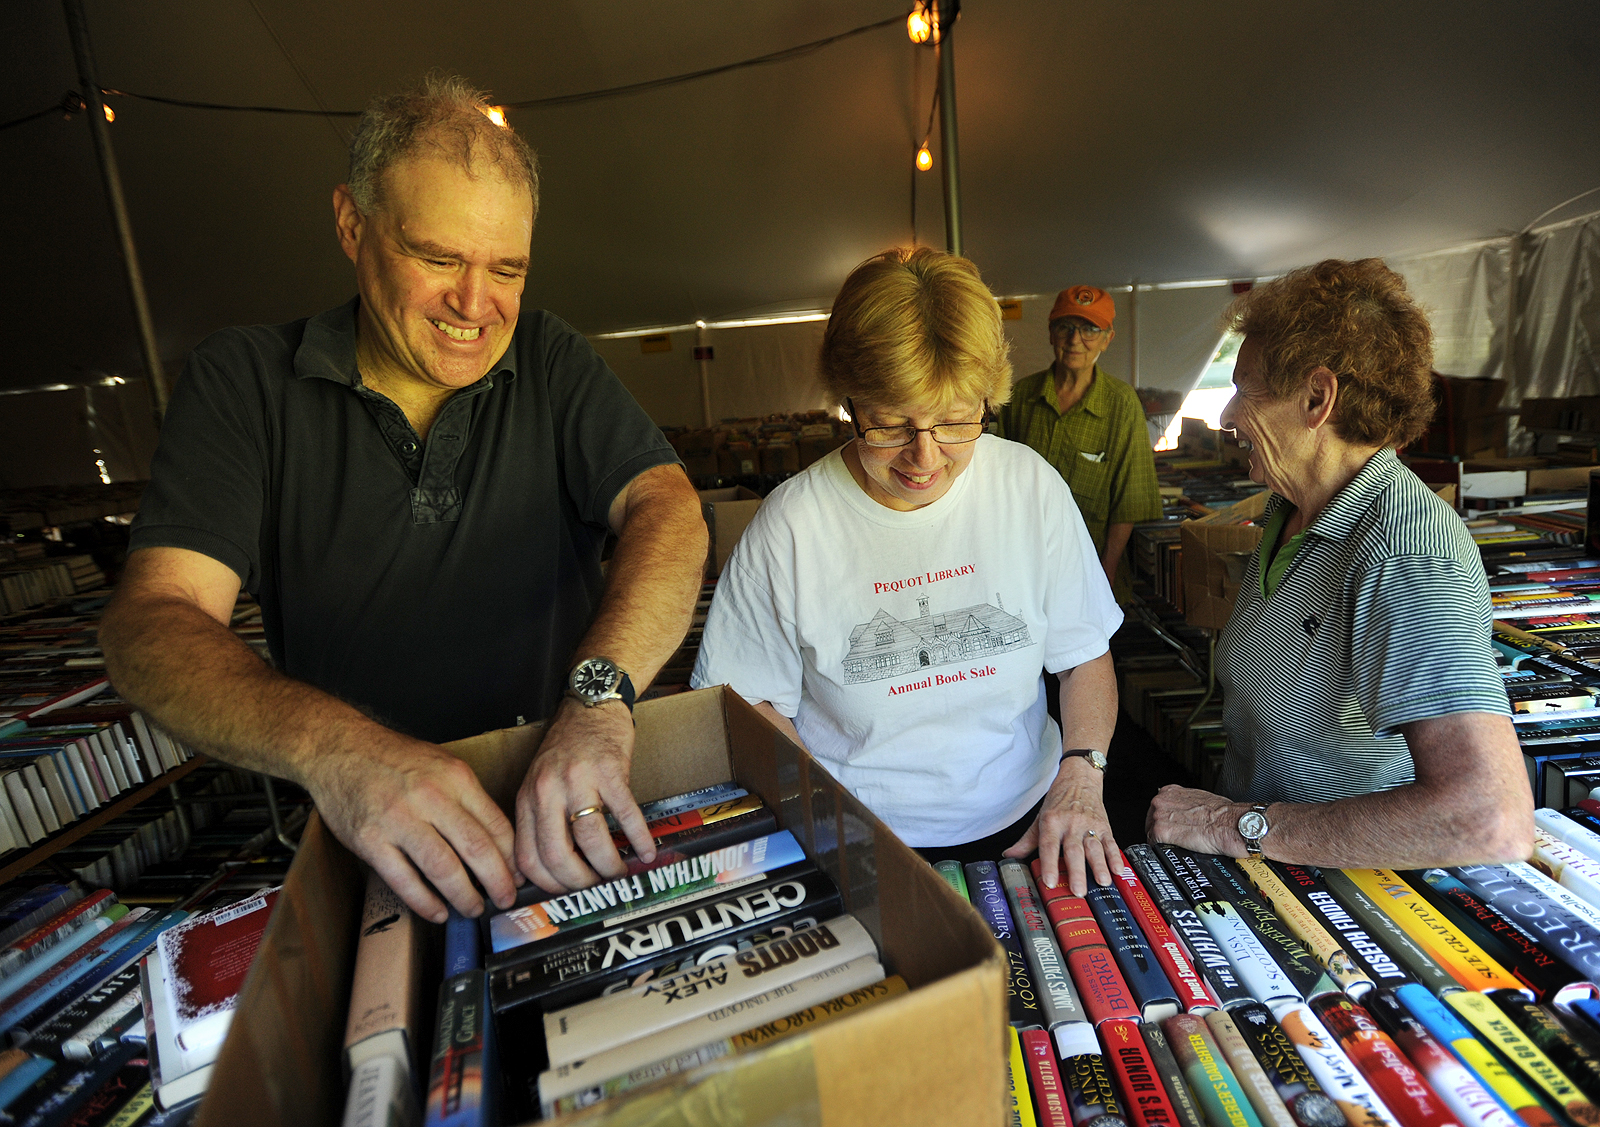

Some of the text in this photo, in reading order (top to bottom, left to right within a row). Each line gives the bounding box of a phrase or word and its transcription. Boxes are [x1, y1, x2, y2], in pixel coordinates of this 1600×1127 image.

[873, 563, 976, 594] PEQUOT LIBRARY
[887, 665, 997, 697] Annual Book Sale
[647, 843, 748, 893] JONATHAN
[1118, 864, 1137, 887] THE JOB
[1147, 858, 1182, 900] HARRY BRANDT
[1147, 872, 1170, 899] RICHARD PRICE
[1162, 848, 1205, 898] EVERY FIFTEEN
[1182, 855, 1211, 885] MINUTES
[1211, 857, 1245, 894] SARA GRUEN
[1379, 874, 1392, 883] is
[1459, 862, 1516, 897] ILE
[540, 875, 644, 923] FRANZEN
[1266, 877, 1287, 897] ANNA
[1378, 883, 1412, 900] W
[601, 881, 806, 970] CENTURY
[979, 877, 1009, 938] Saint Odd
[1238, 896, 1277, 920] EDGE
[1449, 885, 1554, 966] Robert B. Parker's
[1068, 927, 1096, 936] LIGHT
[1134, 891, 1208, 1000] Janet Evanovich LEE GOLDBERG
[1256, 920, 1308, 956] WATER'S
[1282, 902, 1327, 952] STILL LIFE WITH
[1308, 889, 1405, 979] JOSEPH FINDER
[1405, 899, 1498, 979] SUE GRAFTON
[735, 924, 840, 978] ROOTS
[1015, 885, 1074, 1010] JAMES PATTERSON HOPE TO DIE
[1172, 906, 1237, 988] THE WHITES
[1226, 915, 1284, 982] SCOTTOLINE
[1227, 936, 1250, 960] LISA
[88, 972, 135, 1003] KATE
[558, 961, 590, 981] Fred
[641, 961, 725, 997] HALEY
[661, 972, 728, 1004] ALEX
[1008, 951, 1036, 1007] KOONTZ
[1081, 963, 1104, 1003] JAMES LEE
[1089, 952, 1127, 1008] BURKE
[707, 992, 769, 1022] UNLOVED
[773, 983, 796, 1001] THE
[456, 1004, 476, 1043] GRACE
[739, 983, 888, 1047] SANDRA BROWN
[1350, 1015, 1378, 1040] Spy
[1487, 1019, 1520, 1044] BACK
[1523, 1005, 1560, 1030] DEAD
[1118, 1047, 1156, 1091] HONOR
[1188, 1033, 1223, 1079] DAUGHTER
[1256, 1032, 1299, 1083] KING'S
[1259, 1053, 1272, 1069] THE
[1268, 1023, 1319, 1090] DECEPTION
[1370, 1038, 1426, 1100] English
[1512, 1043, 1536, 1060] GO
[1038, 1060, 1055, 1089] LEOTTA
[1068, 1073, 1079, 1089] THE
[1072, 1054, 1099, 1103] KING'S
[1090, 1055, 1118, 1111] DECEPTIO
[1529, 1058, 1573, 1095] NEVER
